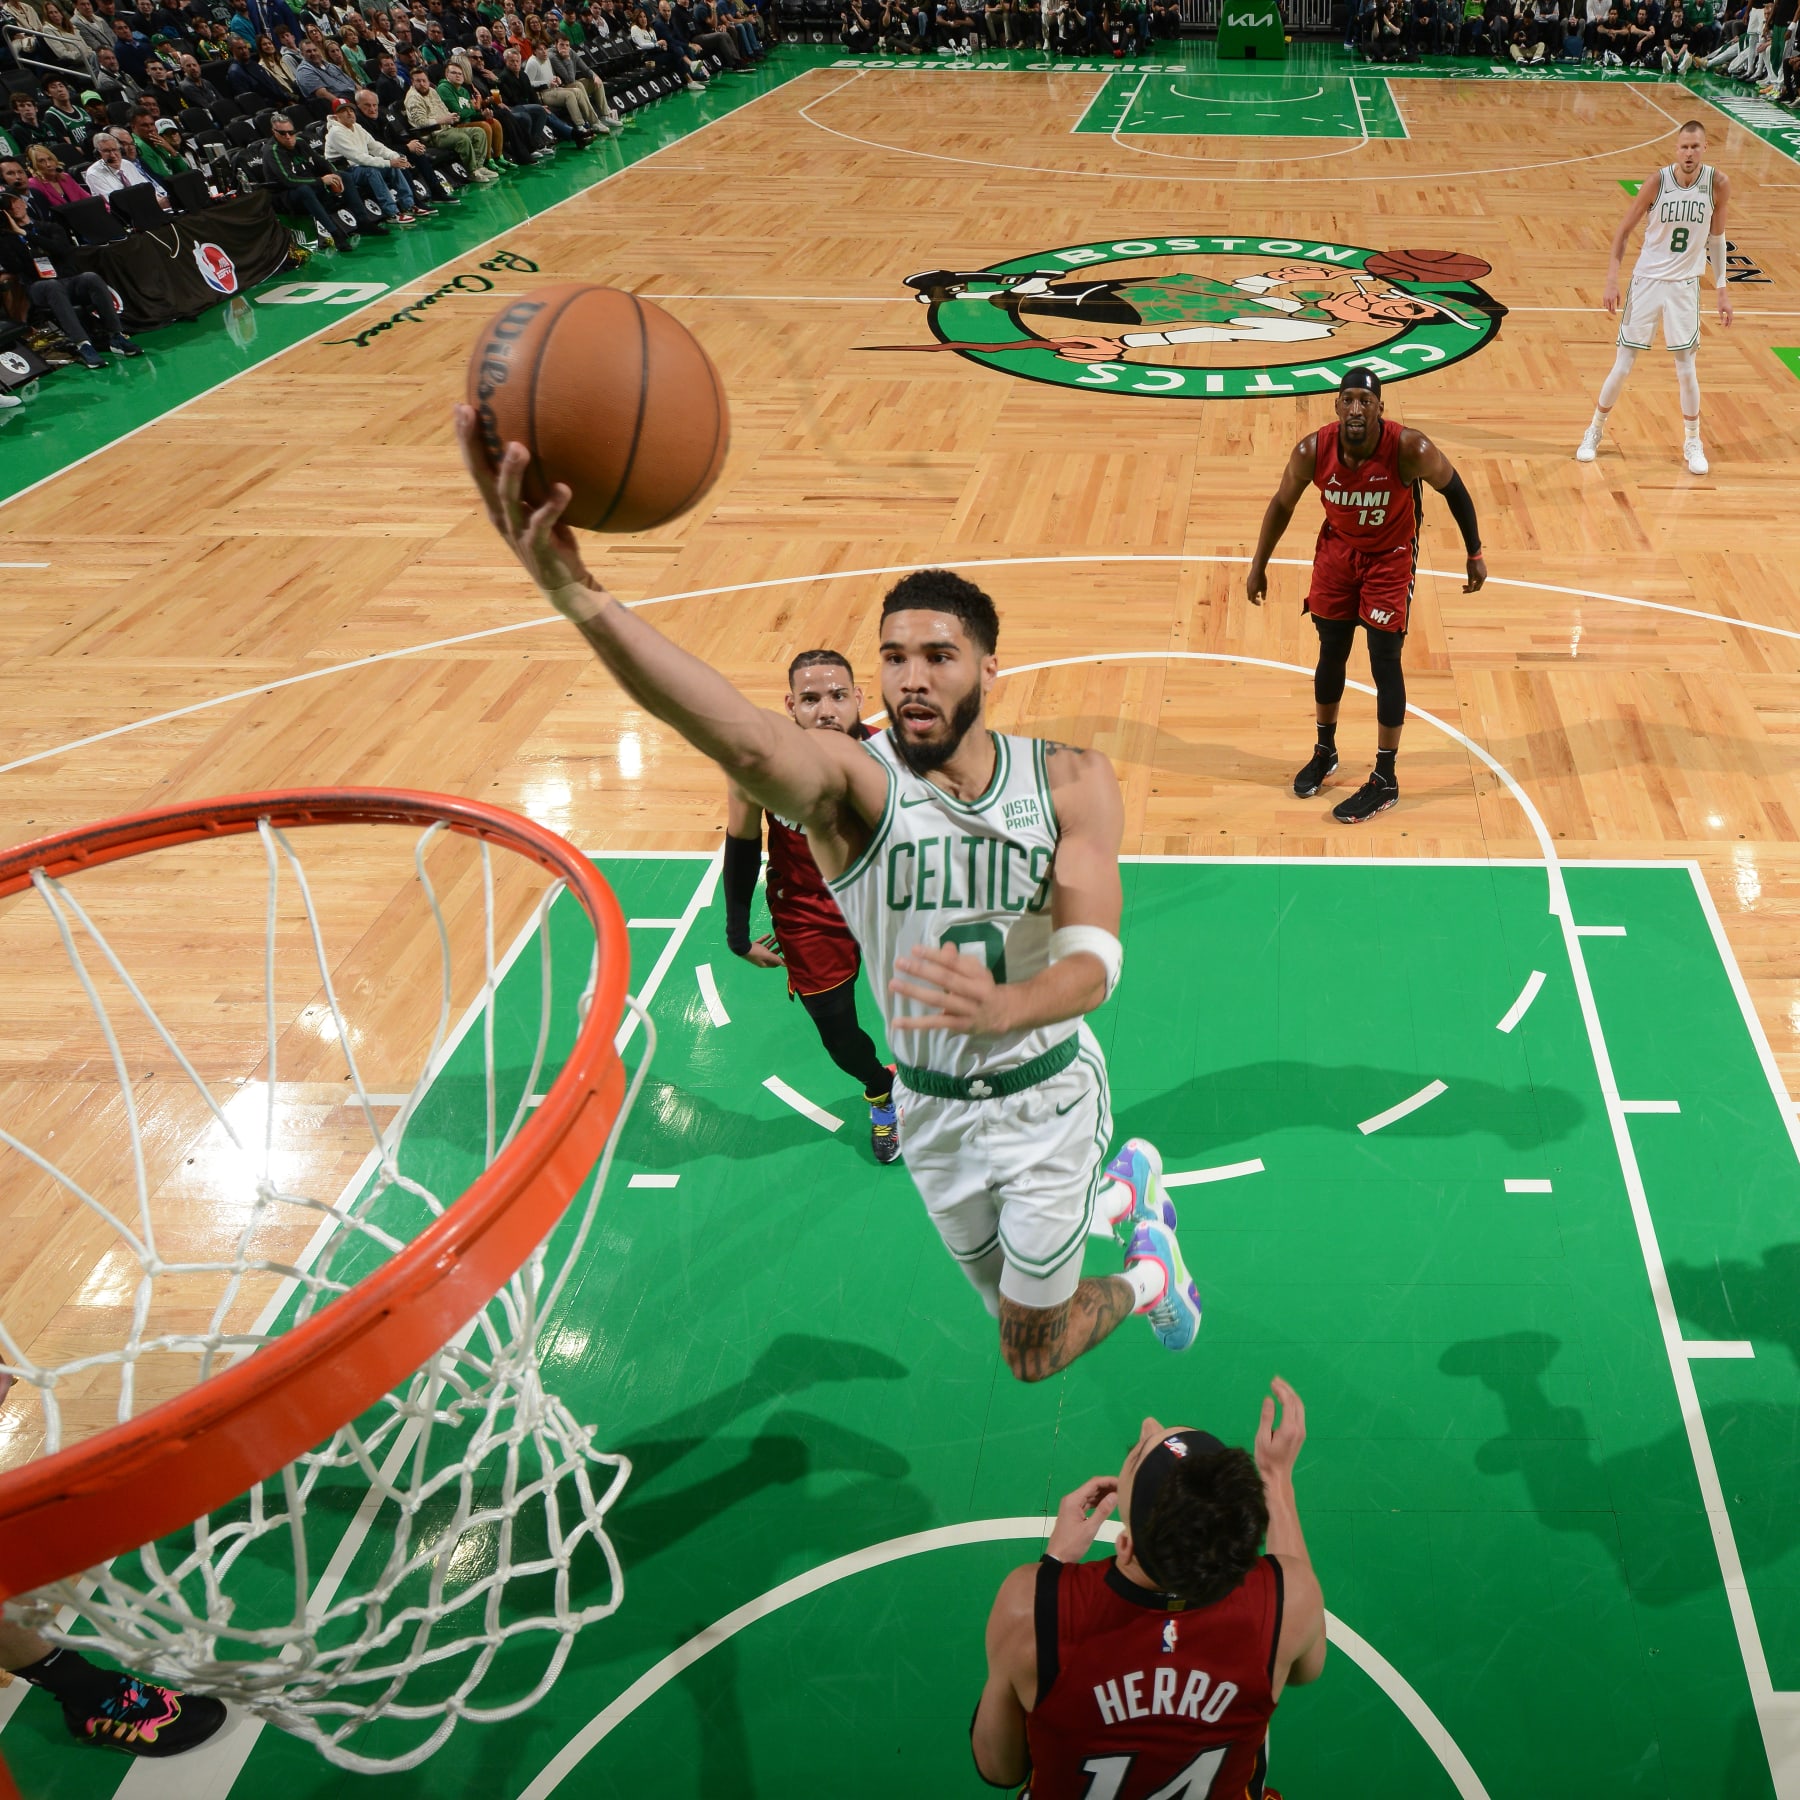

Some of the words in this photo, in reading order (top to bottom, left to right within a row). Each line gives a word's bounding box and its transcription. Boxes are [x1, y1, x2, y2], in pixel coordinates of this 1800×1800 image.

[1227, 13, 1273, 27] KIA
[829, 60, 1010, 70] BOSTON
[1026, 63, 1187, 73] CELTICS
[1520, 67, 1663, 76] ULTRA
[1660, 200, 1706, 224] CELTICS
[1052, 238, 1358, 265] BOSTON
[1670, 227, 1690, 253] 8
[1075, 343, 1446, 394] CELTICS
[1324, 489, 1391, 507] MIAMI
[1358, 509, 1387, 526] 13
[1001, 797, 1039, 820] VISTA
[1006, 812, 1041, 831] PRINT
[886, 835, 1053, 912] CELTICS
[1093, 1667, 1239, 1725] HERRO
